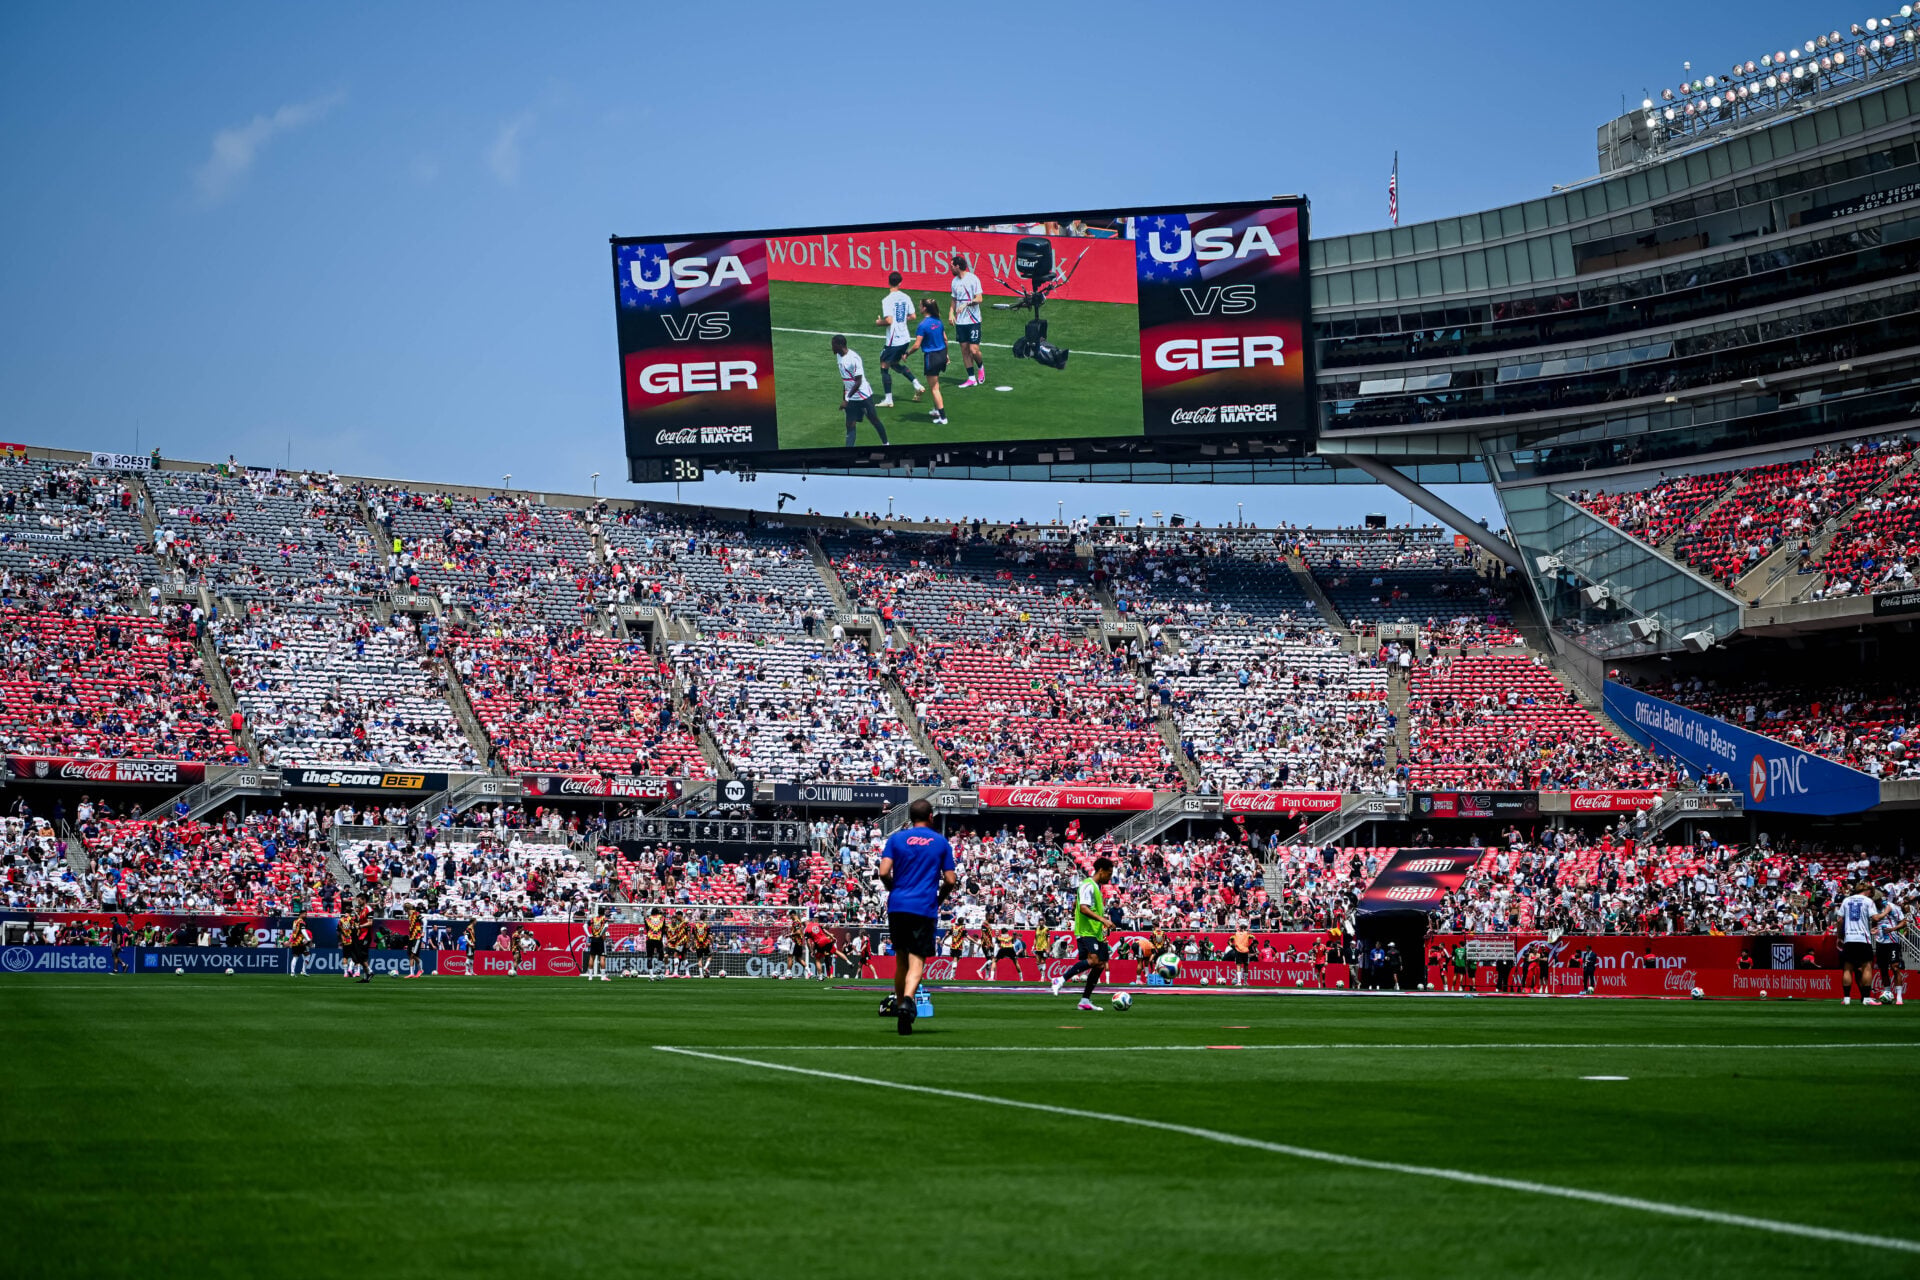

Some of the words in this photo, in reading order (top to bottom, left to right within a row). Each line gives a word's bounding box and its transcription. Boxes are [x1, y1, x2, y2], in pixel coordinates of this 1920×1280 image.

[1865, 192, 1884, 203] FOR
[1888, 183, 1920, 197] SECUR
[1149, 225, 1281, 264] USA
[766, 234, 841, 268] work
[848, 236, 873, 270] is
[878, 238, 980, 275] thirsty
[988, 248, 1069, 283] wk
[630, 256, 752, 290] USA
[1180, 284, 1257, 316] VS
[660, 311, 732, 341] VS
[1155, 335, 1285, 371] GER
[639, 360, 758, 394] GER
[1171, 406, 1219, 425] Coca-Cola
[1220, 404, 1277, 414] SEND-OFF
[1220, 411, 1277, 423] MATCH
[655, 428, 699, 445] Coca-Cola
[701, 425, 752, 434] SEND-OFF
[701, 433, 753, 443] MATCH
[115, 454, 150, 467] SOEST
[163, 585, 175, 594] 350
[185, 586, 197, 594] 351
[1635, 701, 1663, 729] Official
[1664, 709, 1684, 738] Bank
[1685, 719, 1695, 742] of
[1695, 722, 1710, 749] the
[1711, 728, 1737, 762] Bears
[61, 761, 113, 780] Coca-Cola
[116, 763, 177, 772] SEND-OFF
[116, 770, 177, 783] MATCH
[241, 776, 256, 785] 150
[302, 771, 380, 786] theScore
[386, 776, 421, 787] BET
[1768, 754, 1809, 797] PNC
[484, 783, 497, 793] 151
[611, 779, 667, 787] SEND-OFF
[611, 785, 668, 797] MATCH
[726, 786, 746, 796] TNT
[799, 786, 853, 802] HOLLYWOOD
[1008, 788, 1061, 808] Coca-Cola
[1066, 793, 1086, 805] Fan
[1086, 793, 1124, 806] Corner
[719, 802, 751, 811] SPORTS
[1185, 800, 1199, 809] 154
[1227, 792, 1277, 810] Coca-Cola
[1282, 797, 1301, 808] Fan
[1302, 797, 1337, 808] Corner
[1369, 803, 1383, 812] 155
[1460, 796, 1491, 808] VS
[1616, 797, 1630, 805] Fan
[1685, 799, 1698, 808] 101
[35, 952, 107, 968] Allstate
[161, 954, 198, 967] NEW
[201, 954, 244, 967] YORK
[247, 954, 279, 967] LIFE
[1621, 950, 1687, 968] Coner
[1772, 946, 1794, 962] USA
[1891, 950, 1897, 958] 5
[550, 960, 574, 968] Henkel
[1189, 966, 1223, 980] work
[1287, 968, 1318, 981] work
[1550, 971, 1560, 986] is
[1561, 971, 1599, 989] thiry
[1601, 973, 1627, 987] work
[1733, 974, 1749, 988] Fan
[1750, 974, 1771, 989] work
[1772, 975, 1780, 989] is
[1780, 975, 1808, 992] thirsty
[1809, 975, 1832, 990] work
